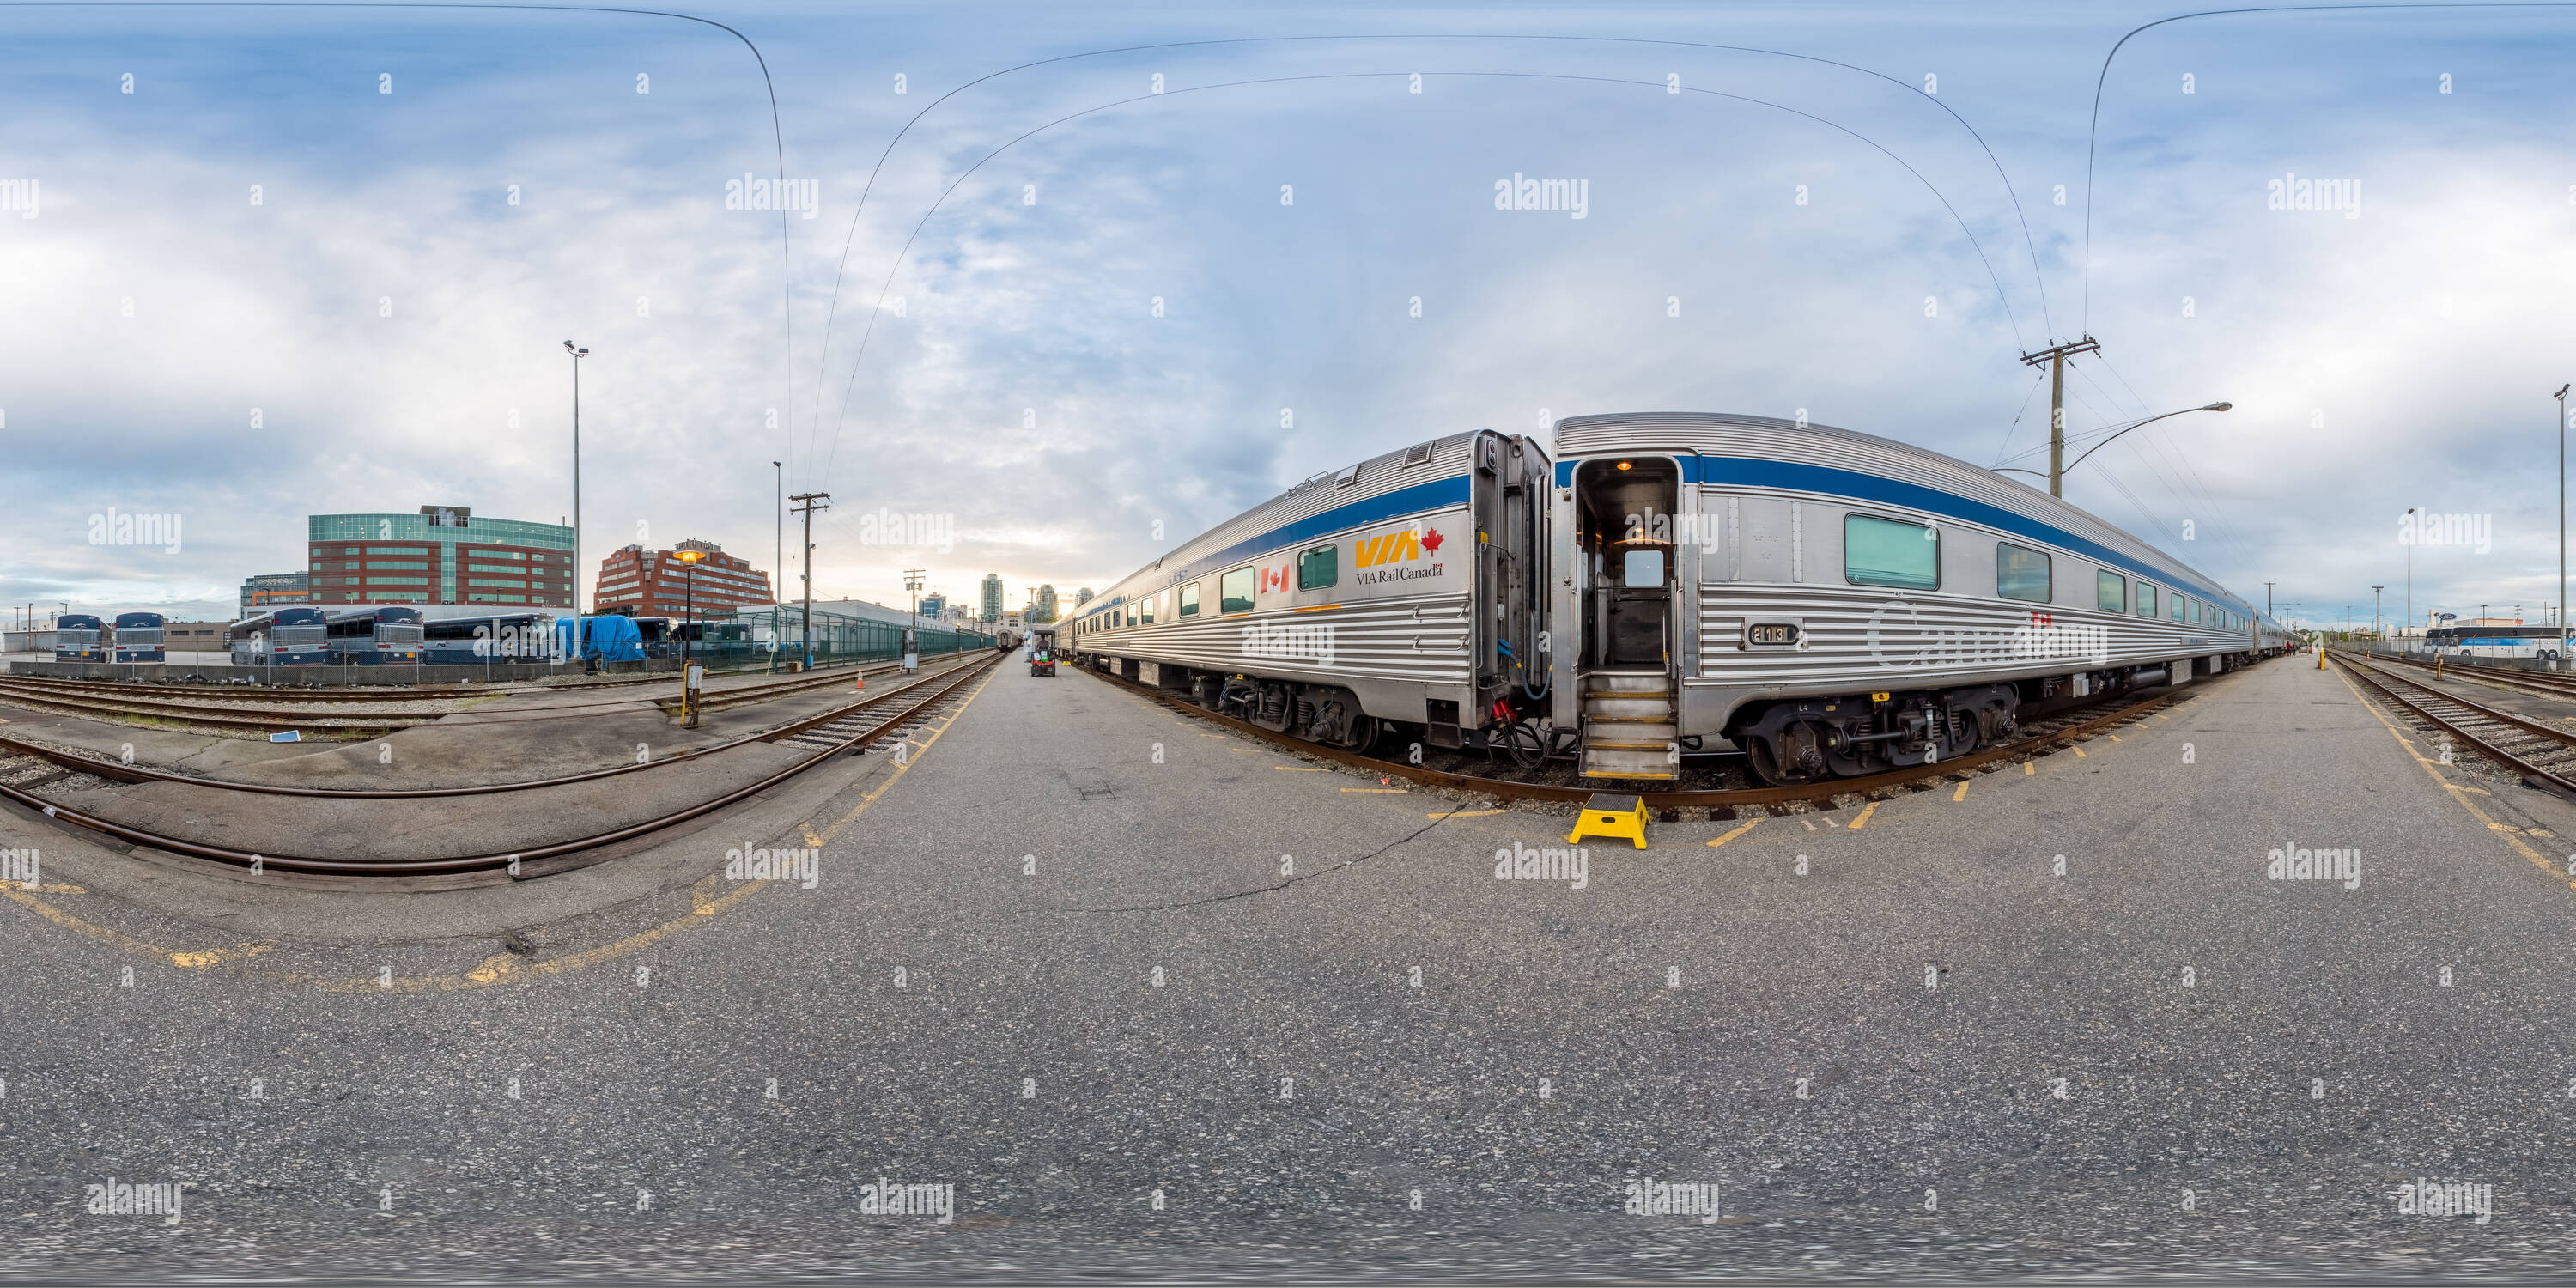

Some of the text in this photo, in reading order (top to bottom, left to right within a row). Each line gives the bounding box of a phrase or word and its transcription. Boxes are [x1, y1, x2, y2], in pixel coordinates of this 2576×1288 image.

[1355, 529, 1419, 569] VIA
[1356, 563, 1443, 586] VIA Rail Canada
[1800, 817, 1839, 831] 11
